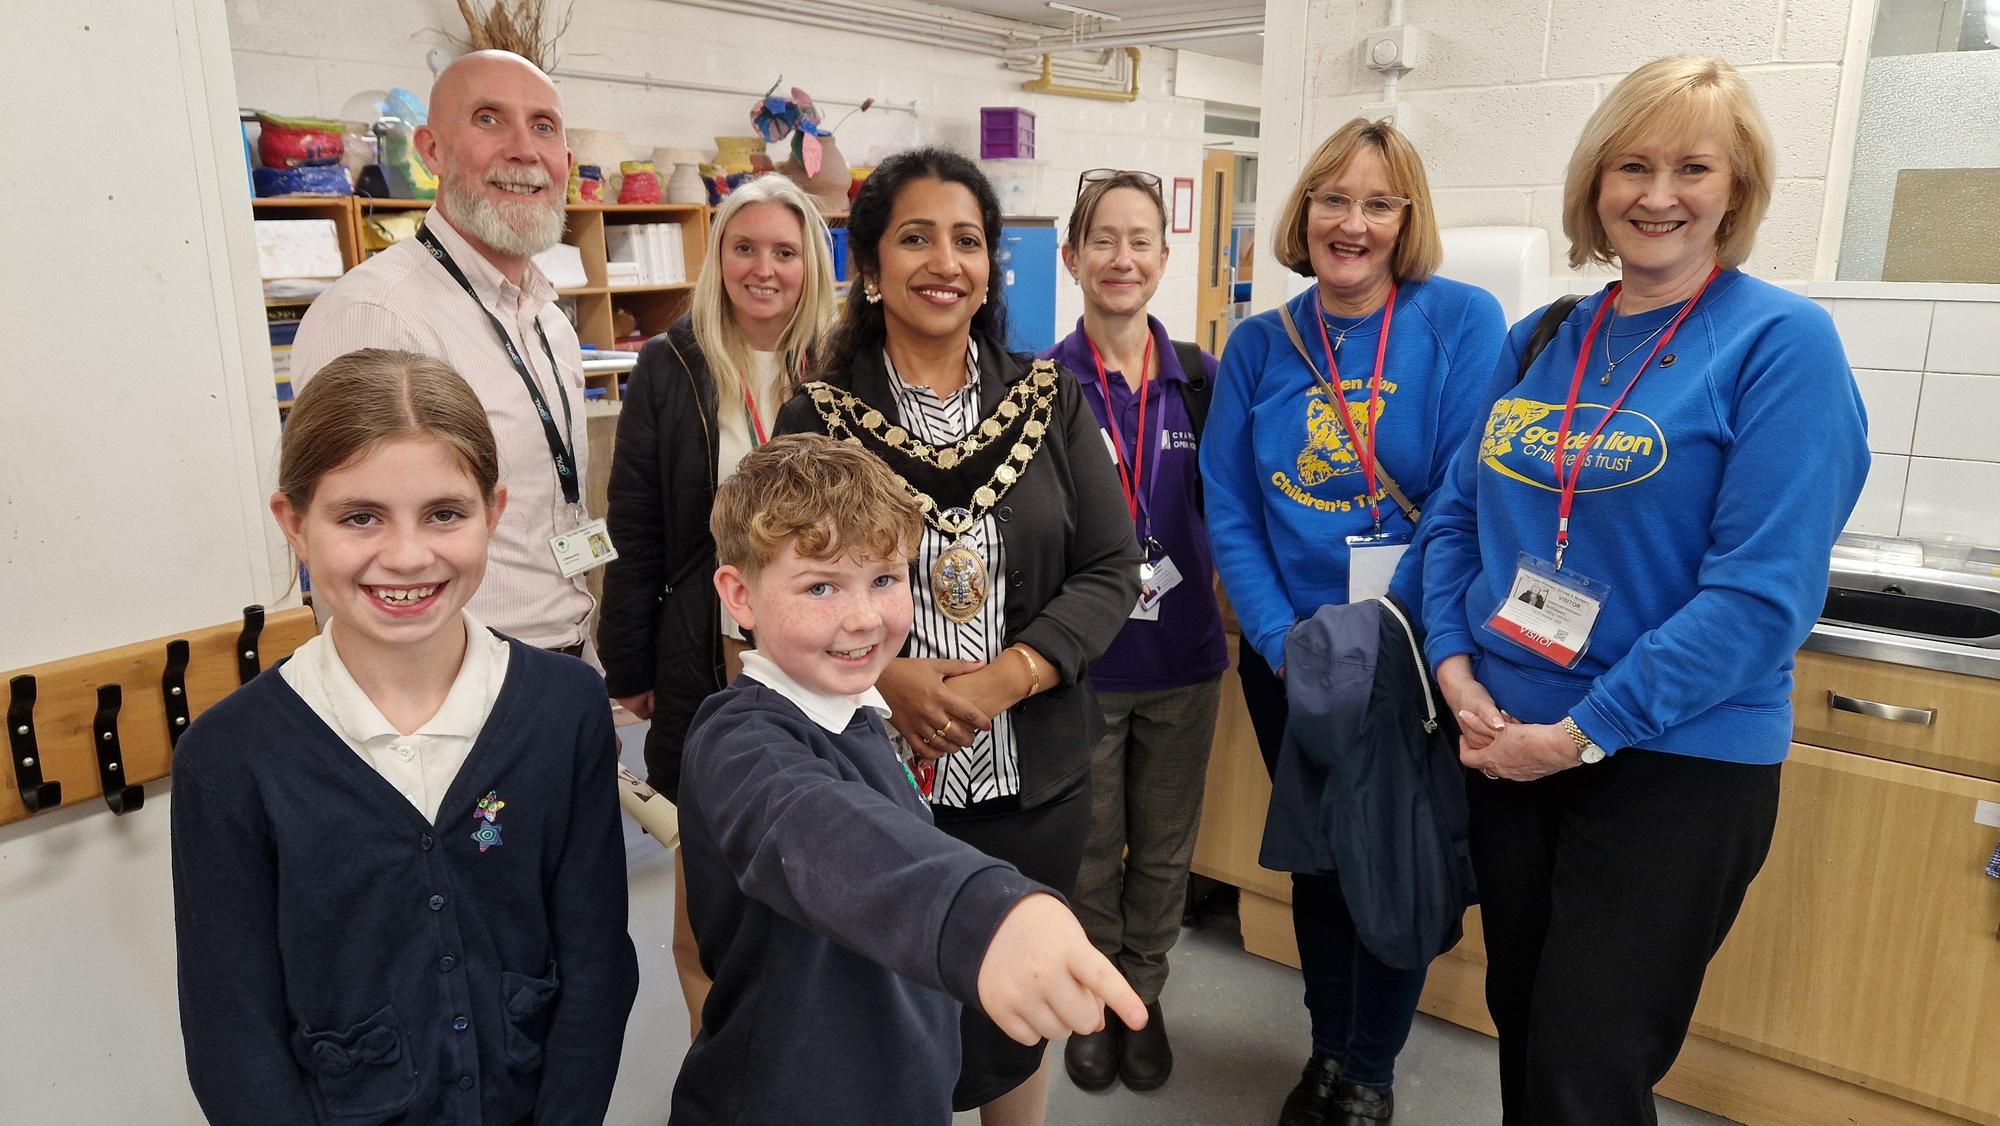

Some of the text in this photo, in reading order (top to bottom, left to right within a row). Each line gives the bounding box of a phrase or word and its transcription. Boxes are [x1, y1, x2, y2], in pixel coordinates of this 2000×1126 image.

[1603, 431, 1653, 456] lion
[1594, 452, 1633, 472] trust
[1271, 471, 1351, 512] Children's
[1559, 596, 1581, 609] VISITOR
